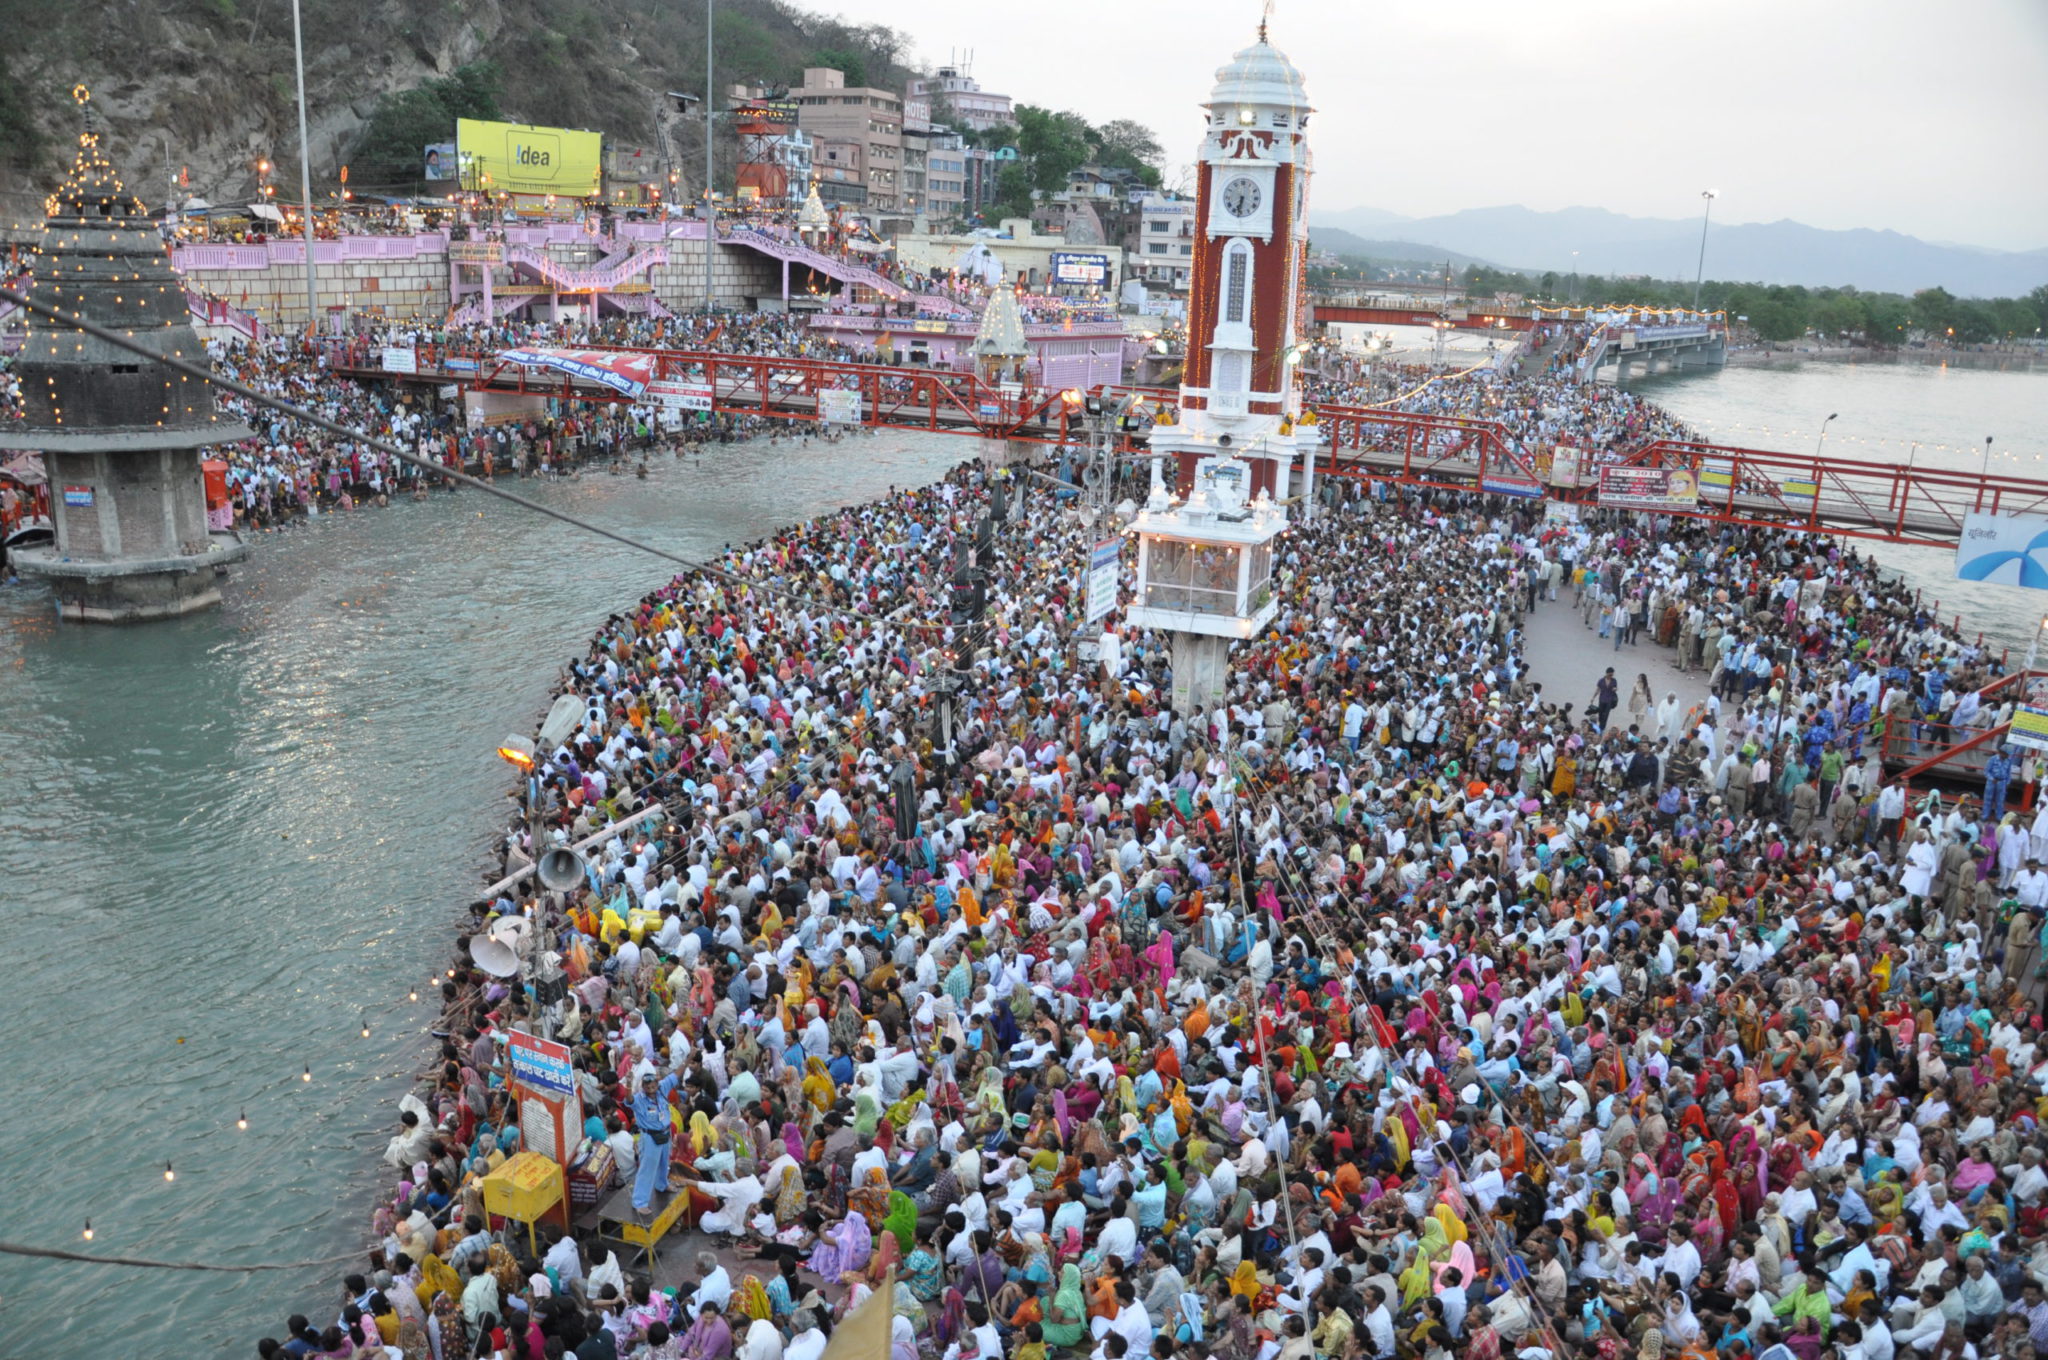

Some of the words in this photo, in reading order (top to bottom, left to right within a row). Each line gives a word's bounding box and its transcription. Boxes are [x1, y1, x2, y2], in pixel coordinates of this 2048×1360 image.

[904, 100, 930, 120] HOTEL
[603, 371, 631, 391] हरिद्वार
[1635, 469, 1661, 477] 2010
